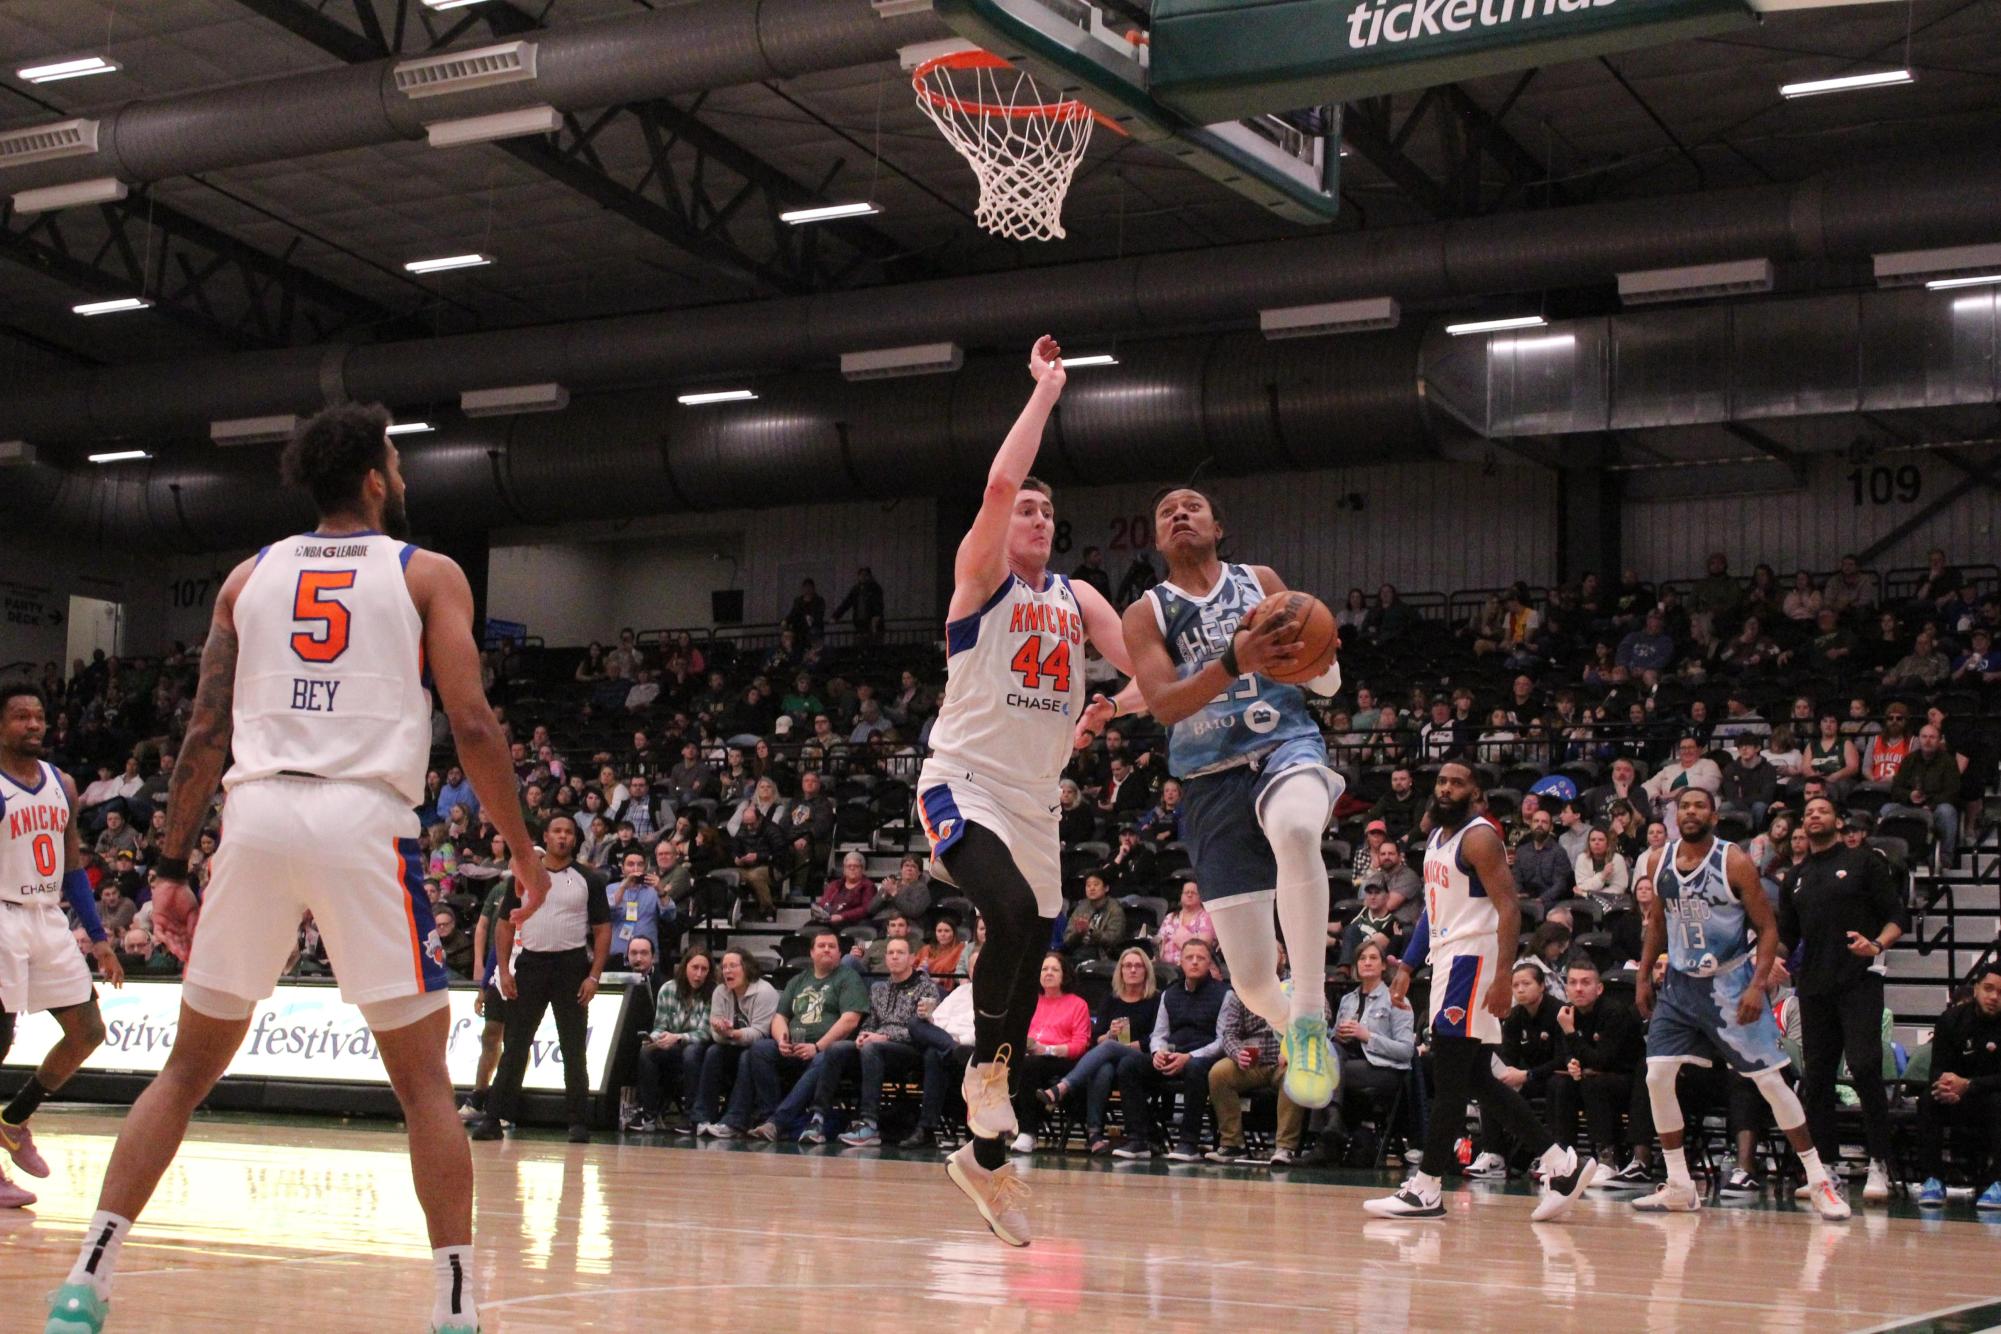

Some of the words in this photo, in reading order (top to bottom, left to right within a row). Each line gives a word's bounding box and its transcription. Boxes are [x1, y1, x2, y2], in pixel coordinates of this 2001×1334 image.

[1347, 0, 1617, 49] ticketm
[1847, 465, 1920, 505] 109
[1109, 515, 1156, 550] 20
[303, 546, 321, 558] NBA
[322, 546, 337, 558] G
[336, 545, 368, 557] LEAGUE
[5, 597, 43, 613] PARTY
[168, 579, 210, 607] 107
[7, 611, 40, 625] DECK
[290, 569, 357, 663] 5
[1010, 602, 1081, 645] KNICKS
[1181, 616, 1244, 662] HER
[1011, 634, 1070, 692] 44
[291, 678, 340, 711] BEY
[1007, 693, 1061, 712] CHASE
[1880, 762, 1896, 777] 15
[9, 804, 68, 840] KNICKS
[32, 833, 56, 876] 0
[20, 882, 57, 895] CHASE
[1423, 860, 1450, 889] NICKS
[1679, 922, 1706, 949] 13
[104, 1014, 176, 1052] stiva
[248, 1012, 379, 1061] festiva
